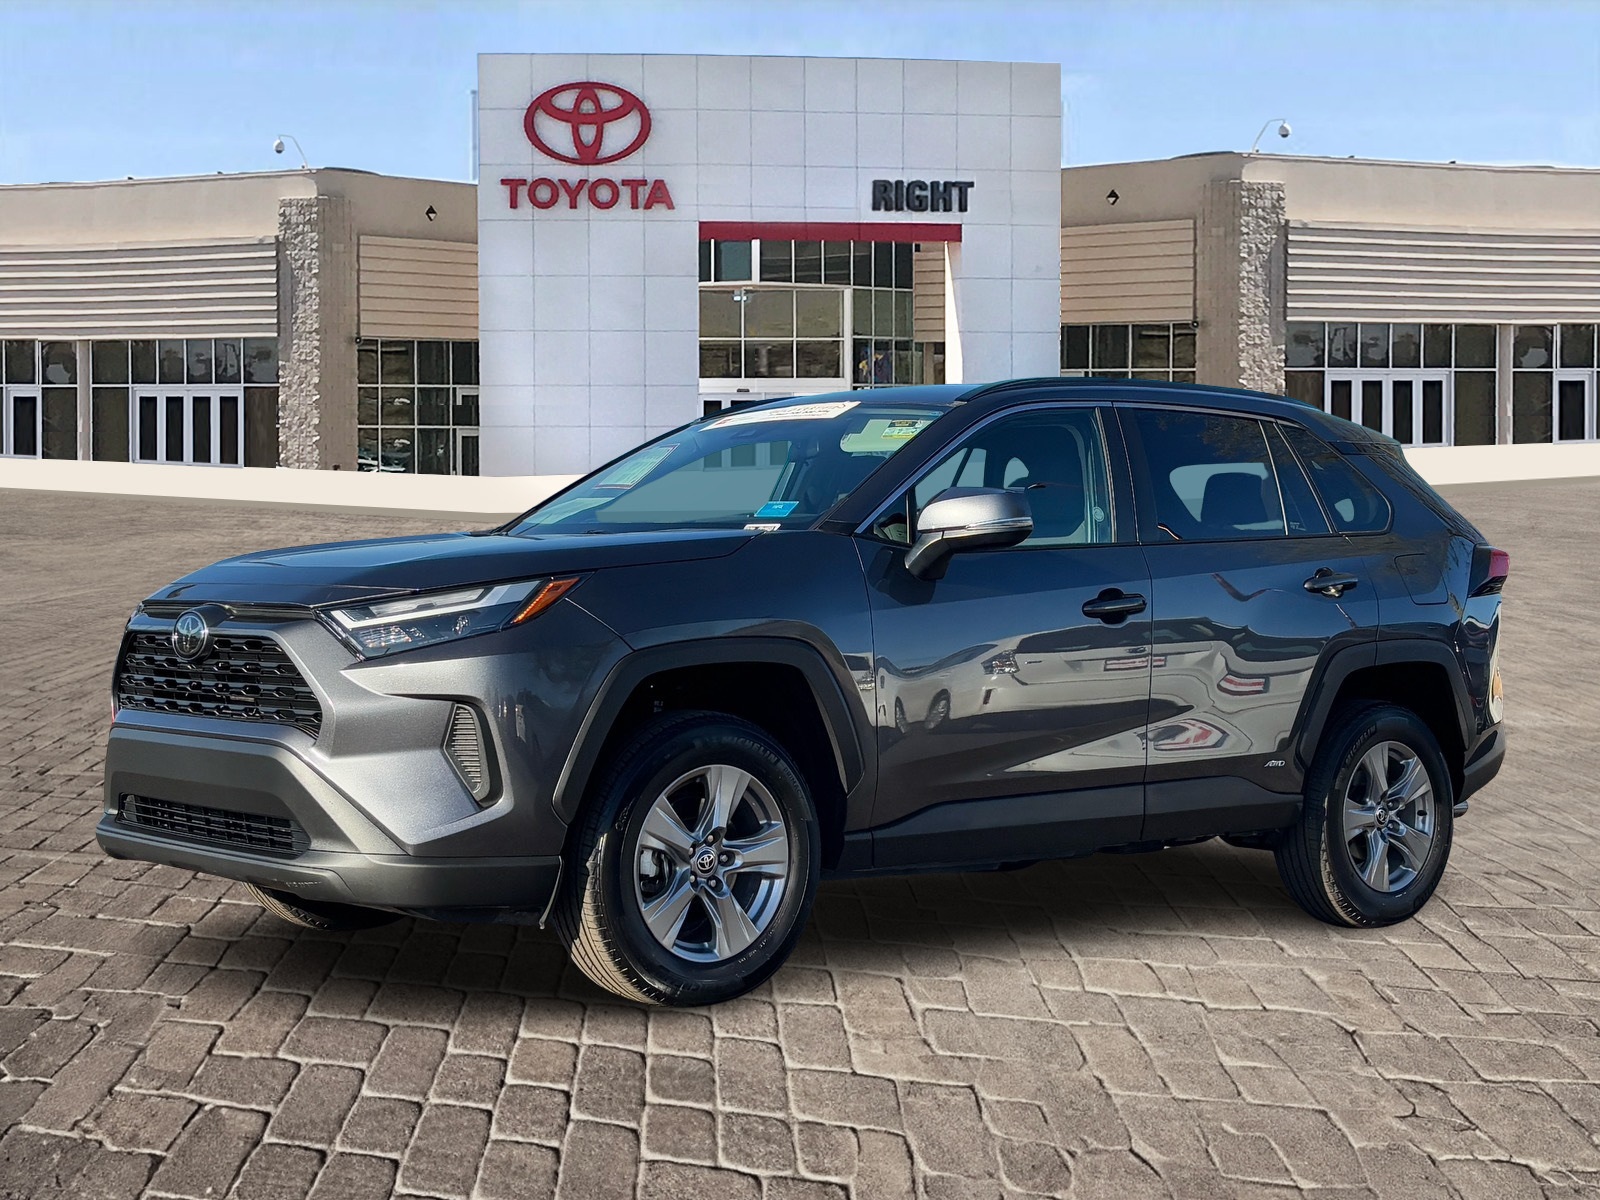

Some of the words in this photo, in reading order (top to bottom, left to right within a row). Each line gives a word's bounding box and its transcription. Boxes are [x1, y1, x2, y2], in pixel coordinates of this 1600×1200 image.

[500, 178, 676, 210] TOYOTA
[871, 180, 975, 213] RIGHT
[721, 736, 778, 764] MICHELIN
